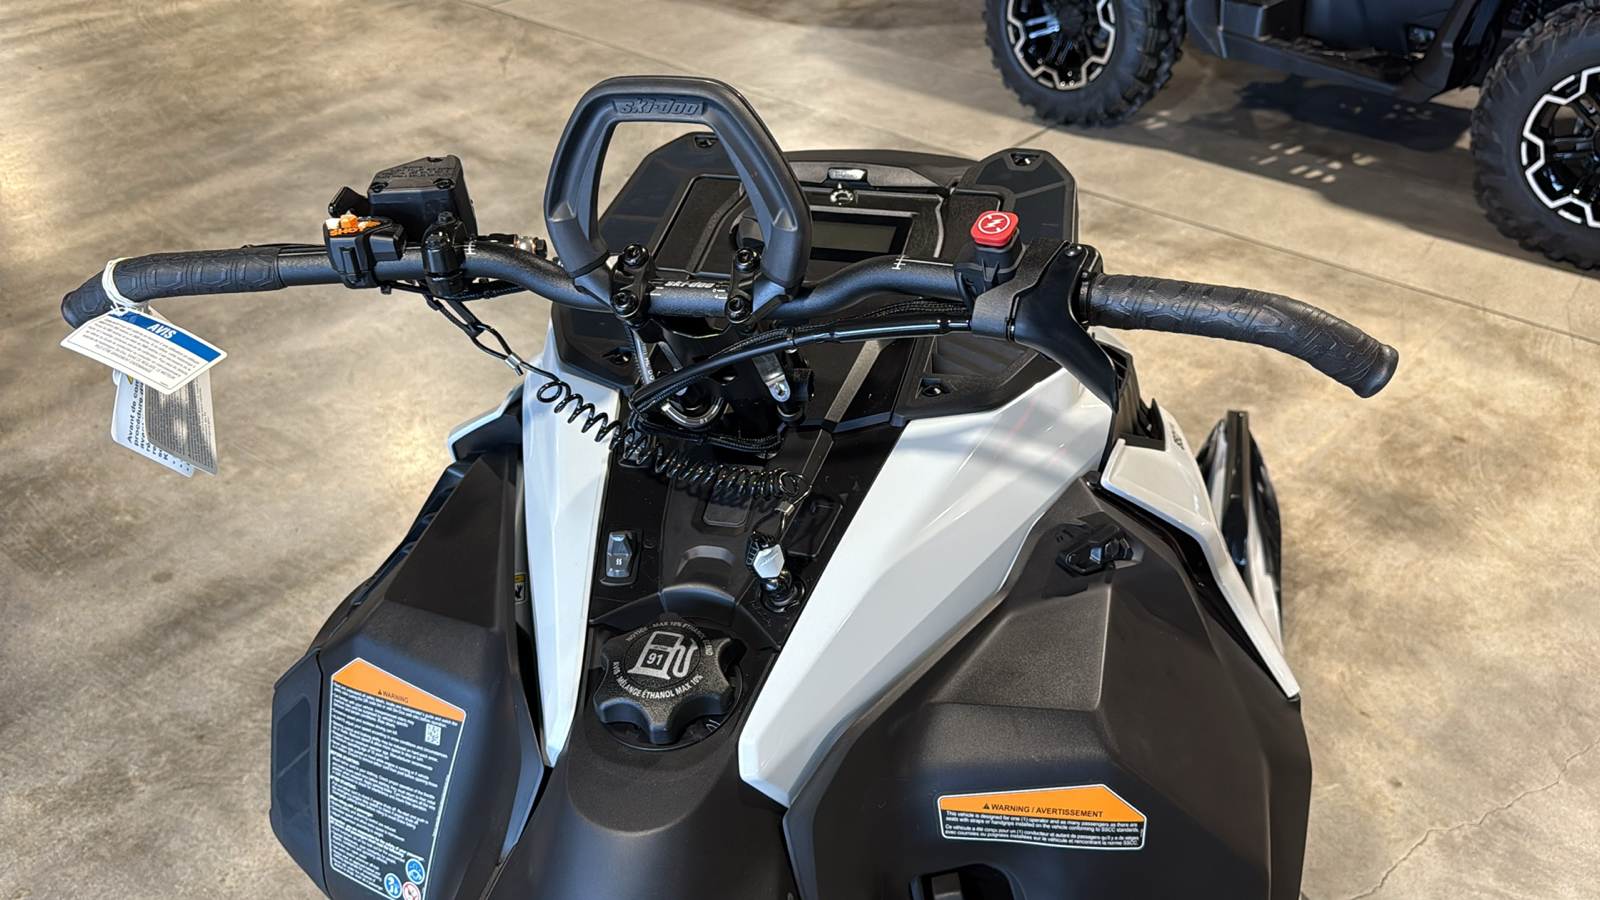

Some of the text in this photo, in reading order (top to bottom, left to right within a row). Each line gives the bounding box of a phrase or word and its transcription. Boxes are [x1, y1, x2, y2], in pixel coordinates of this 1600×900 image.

[146, 323, 178, 340] AVIS
[131, 400, 136, 413] de
[134, 398, 143, 446] procédure
[626, 627, 648, 642] NOTICE
[646, 652, 663, 665] 91
[642, 689, 674, 699] ÉTHANOL
[675, 683, 691, 695] MAX
[690, 674, 704, 685] 10%
[382, 690, 409, 704] WARNING
[991, 804, 1030, 813] WARNING
[1036, 807, 1104, 817] AVERTISSEMENT
